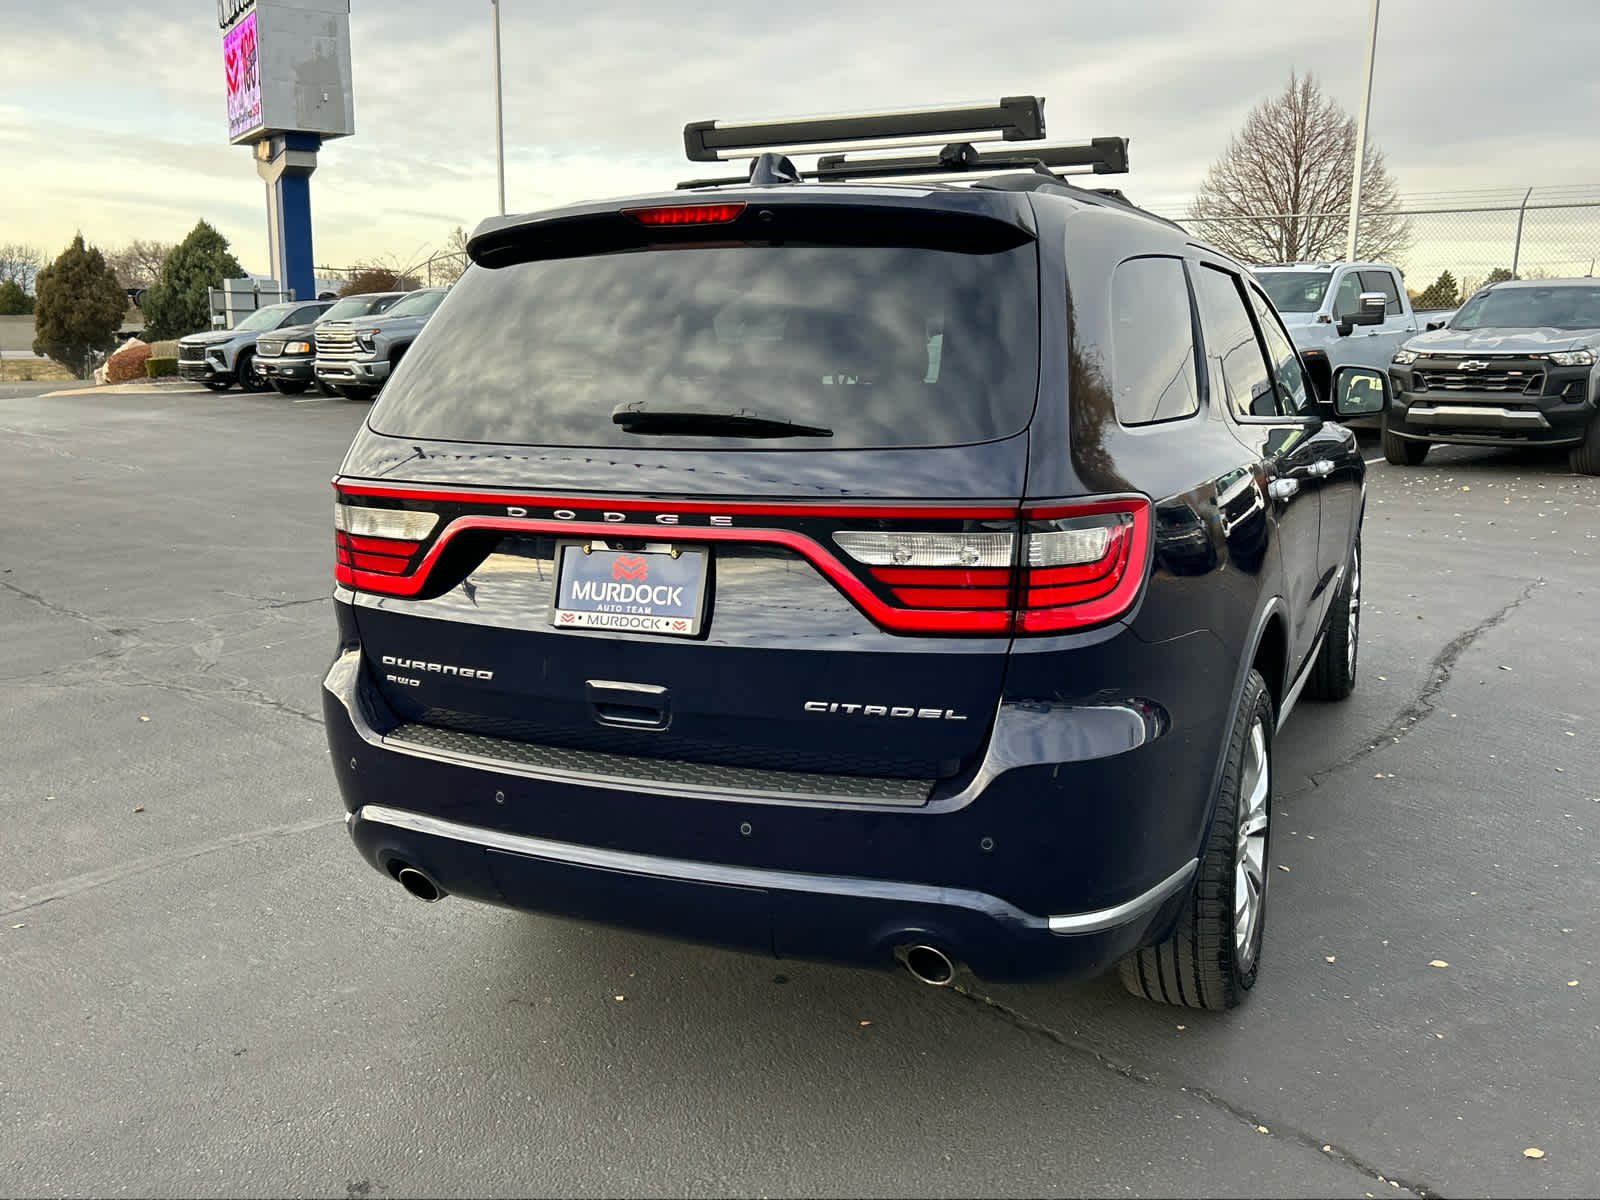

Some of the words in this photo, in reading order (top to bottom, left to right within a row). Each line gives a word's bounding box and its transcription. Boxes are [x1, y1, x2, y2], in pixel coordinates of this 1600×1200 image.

[506, 506, 733, 526] DODGE
[571, 580, 684, 607] MURDOCK
[596, 603, 623, 613] AUTO
[626, 605, 652, 615] TEAM
[586, 614, 662, 630] MURDOCK
[382, 655, 494, 680] DURANGO
[386, 674, 421, 687] AWD
[804, 701, 968, 720] CITADEL
